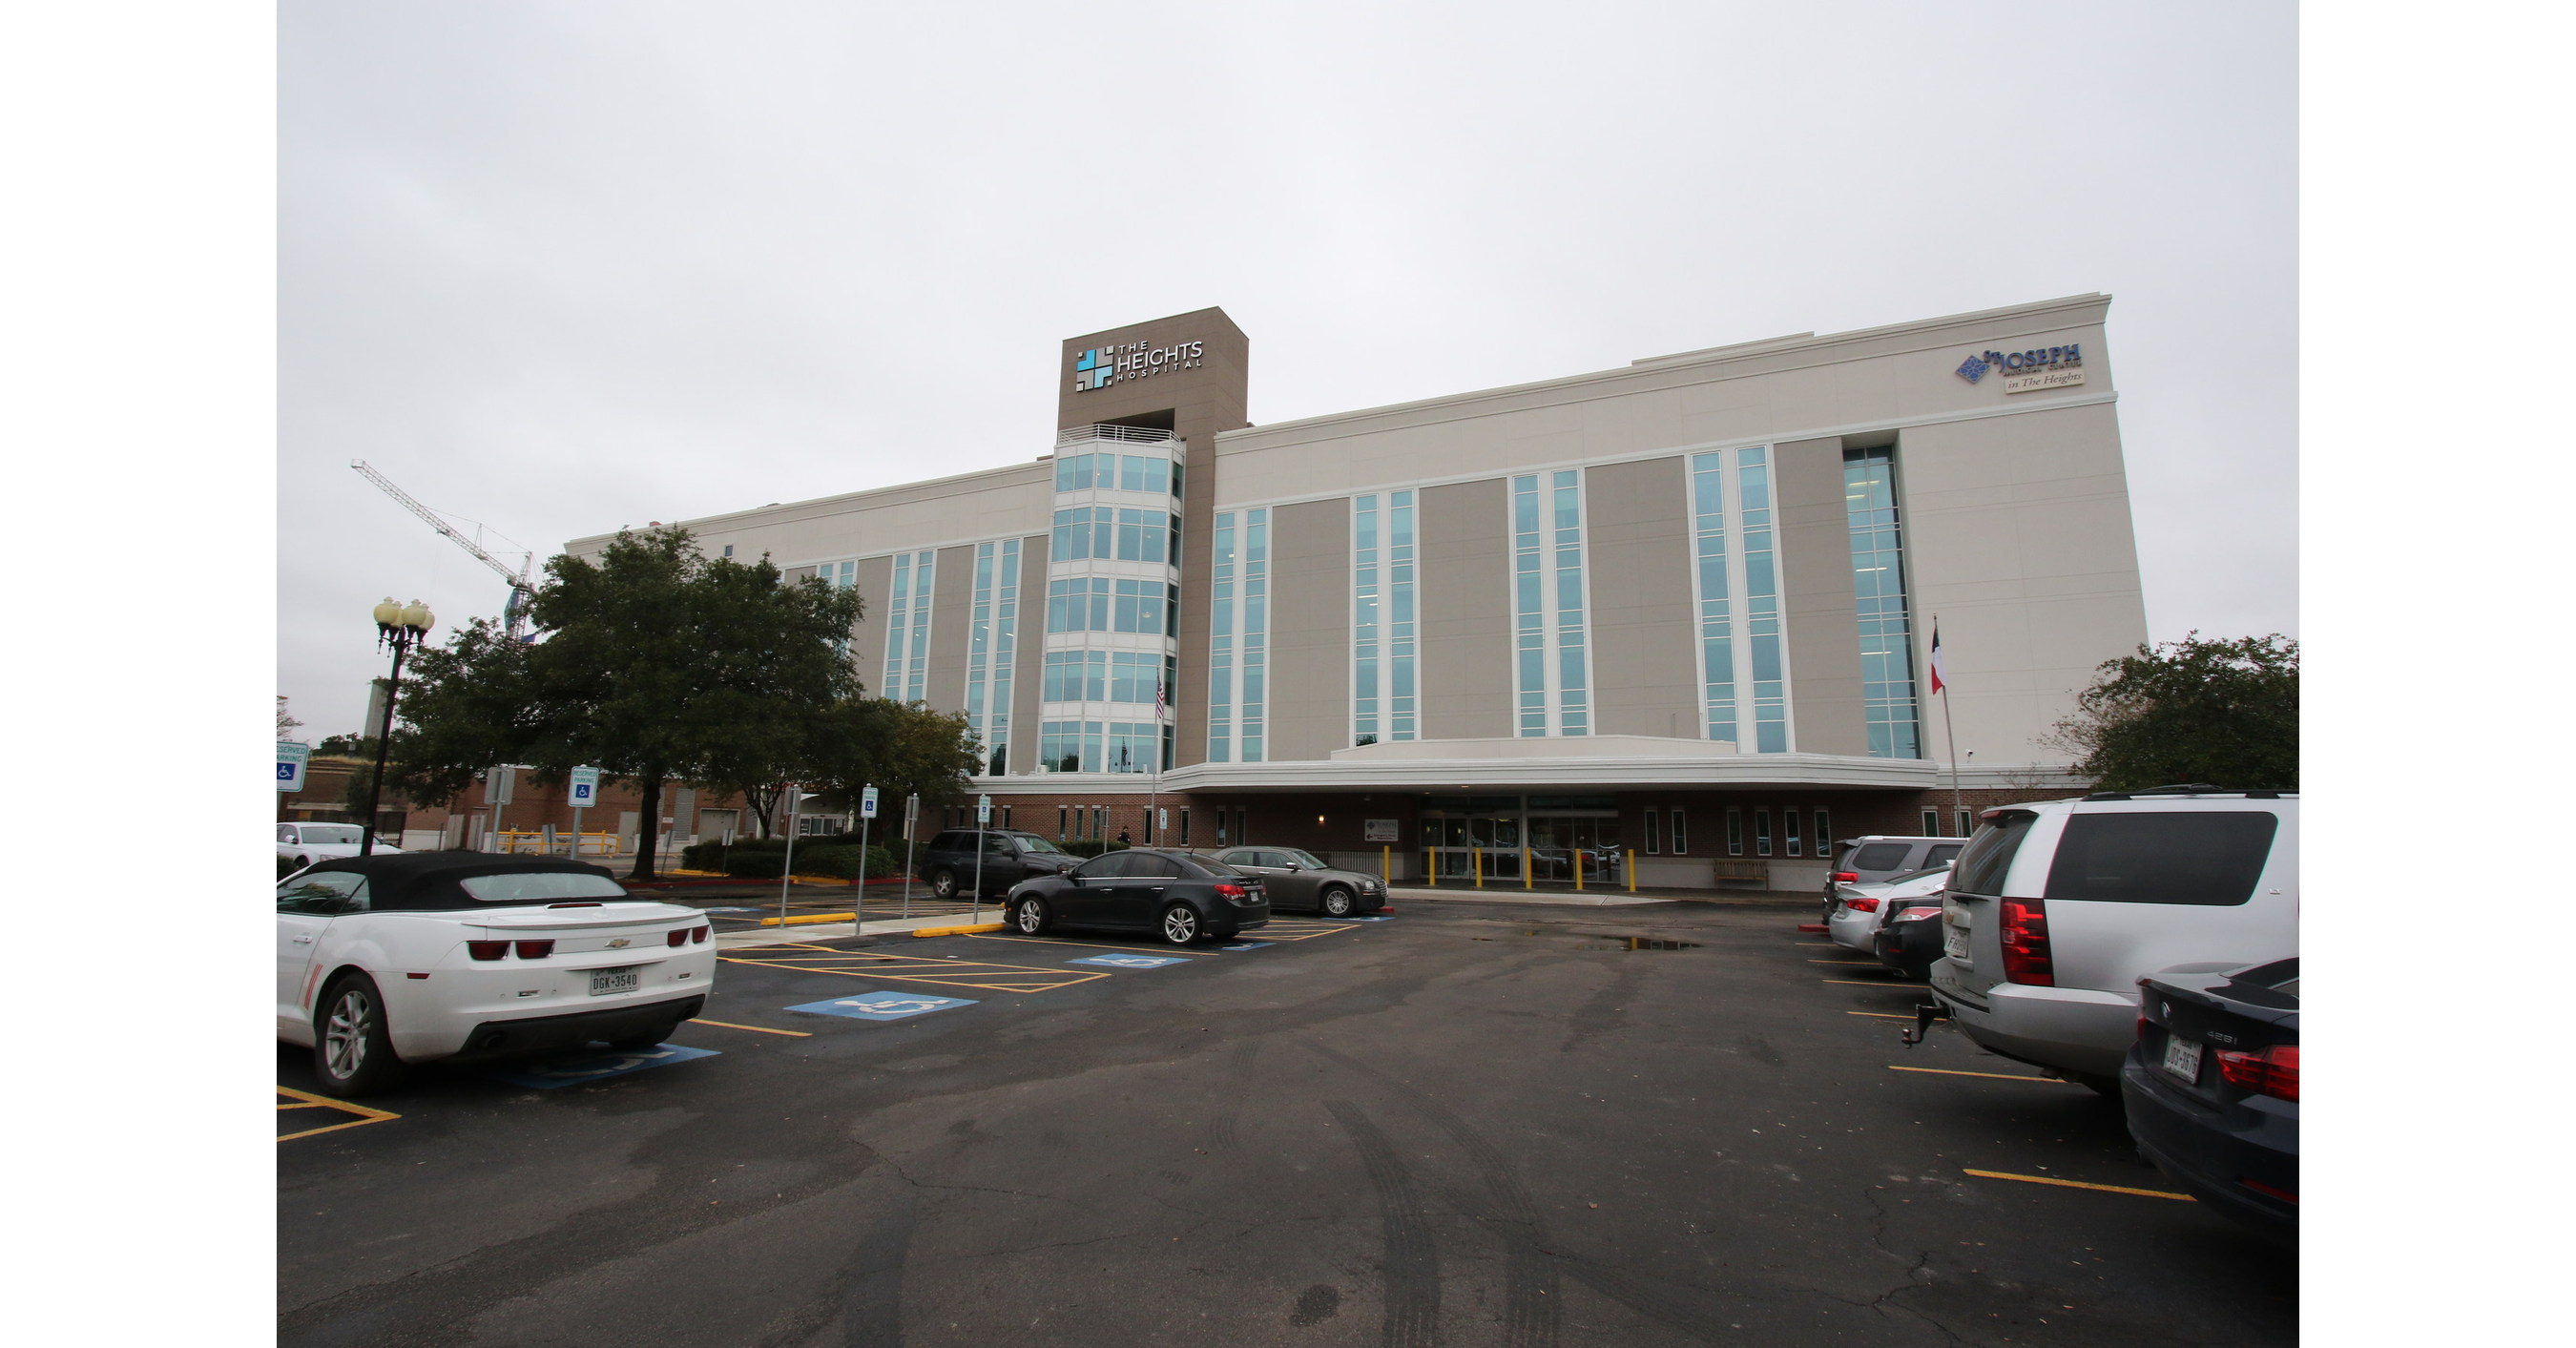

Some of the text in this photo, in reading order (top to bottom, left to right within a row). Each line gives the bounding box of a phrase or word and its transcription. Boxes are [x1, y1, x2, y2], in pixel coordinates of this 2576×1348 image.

[1118, 340, 1148, 355] THE
[1117, 341, 1203, 373] HEIGHTS
[1999, 343, 2082, 373] JOSEPH
[1116, 359, 1202, 383] HOSPITAL
[2007, 372, 2083, 389] in The Heights
[277, 746, 306, 755] ESERVED
[277, 754, 302, 762] ARKING
